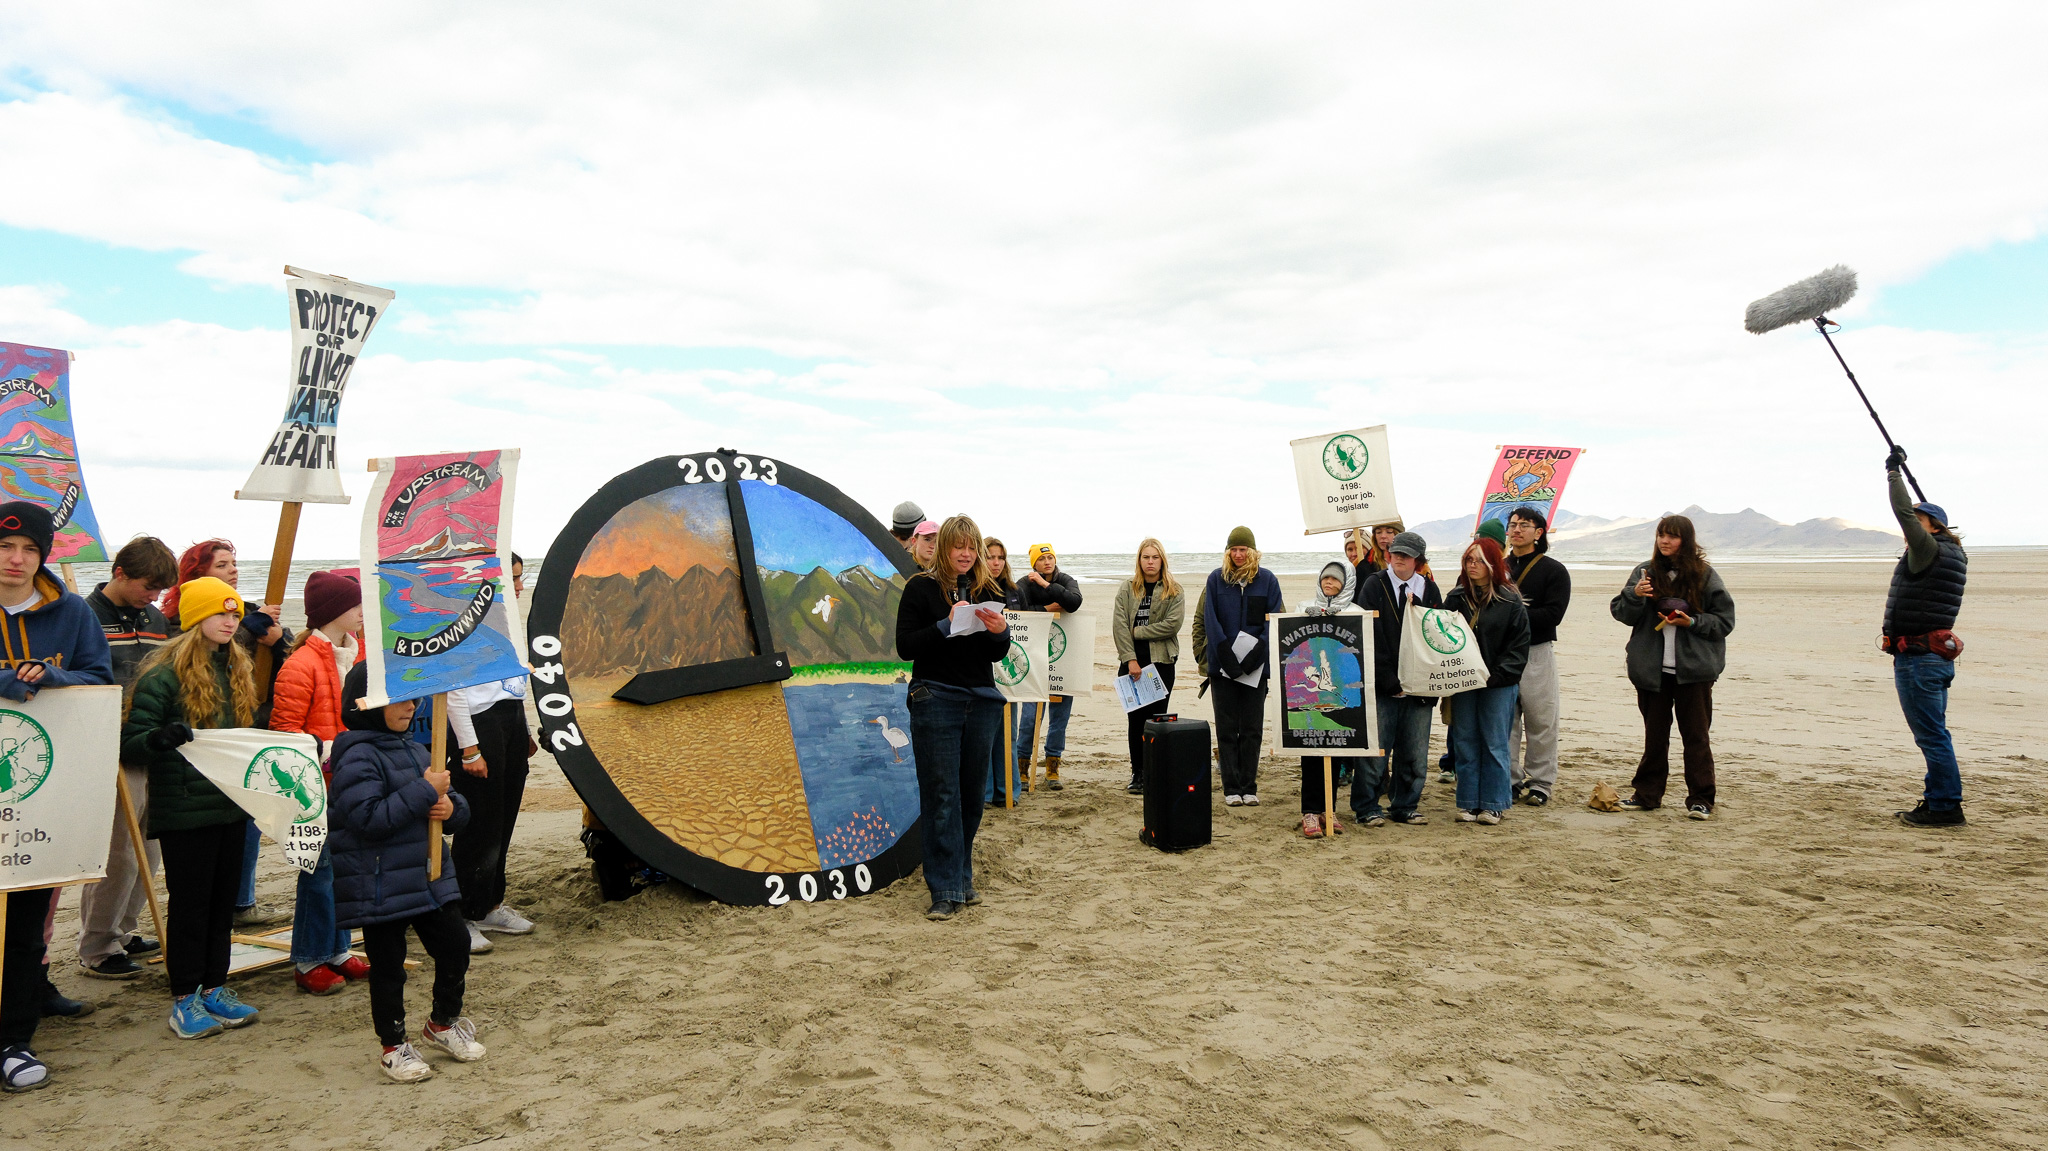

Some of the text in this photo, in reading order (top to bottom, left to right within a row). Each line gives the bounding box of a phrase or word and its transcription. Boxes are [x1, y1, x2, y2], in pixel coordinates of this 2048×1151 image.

[295, 288, 377, 342] PROTECT
[316, 333, 344, 351] OUR
[0, 378, 53, 408] STREAM,
[290, 420, 319, 434] AN
[1503, 448, 1572, 460] DEFEND
[678, 456, 778, 486] 2023
[397, 463, 486, 504] UPSTREAM,
[1340, 481, 1362, 491] 4198:
[1327, 495, 1339, 503] Do
[1340, 493, 1358, 503] your
[1336, 502, 1369, 513] legislate
[391, 510, 401, 526] ARE
[397, 511, 406, 526] ALL
[411, 584, 494, 657] DOWNWIND
[1016, 634, 1029, 642] late
[1281, 623, 1357, 647] WATER IS LIFE
[1440, 658, 1464, 668] 4198:
[1048, 674, 1064, 682] fore
[1429, 668, 1476, 680] Act before
[1428, 679, 1478, 691] it's too late
[532, 635, 584, 751] 2040
[1292, 728, 1357, 738] DEFEND GREAT
[1302, 737, 1347, 746] SALT LAKE
[14, 828, 52, 847] job,
[297, 856, 315, 870] too
[765, 863, 873, 905] 2030
